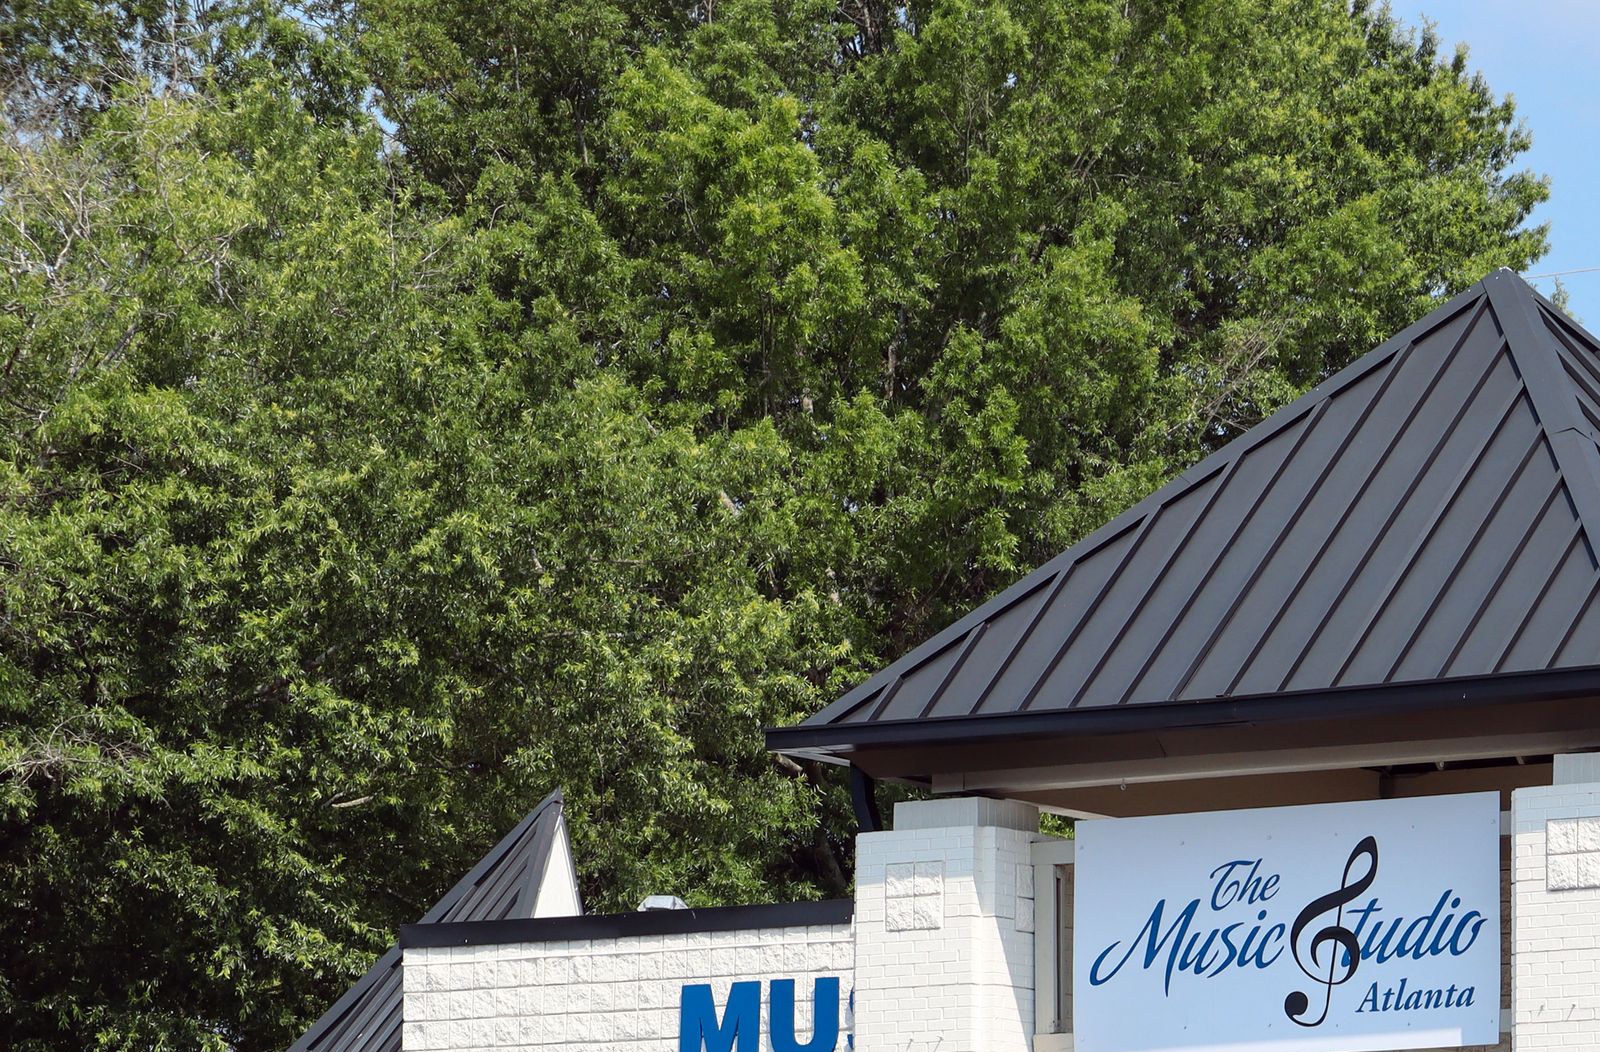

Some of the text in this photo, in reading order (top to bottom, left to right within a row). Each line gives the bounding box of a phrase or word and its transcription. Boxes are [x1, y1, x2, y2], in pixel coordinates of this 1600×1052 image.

[1209, 858, 1280, 911] The
[1088, 898, 1286, 998] Music
[1354, 977, 1476, 1014] Atlanta
